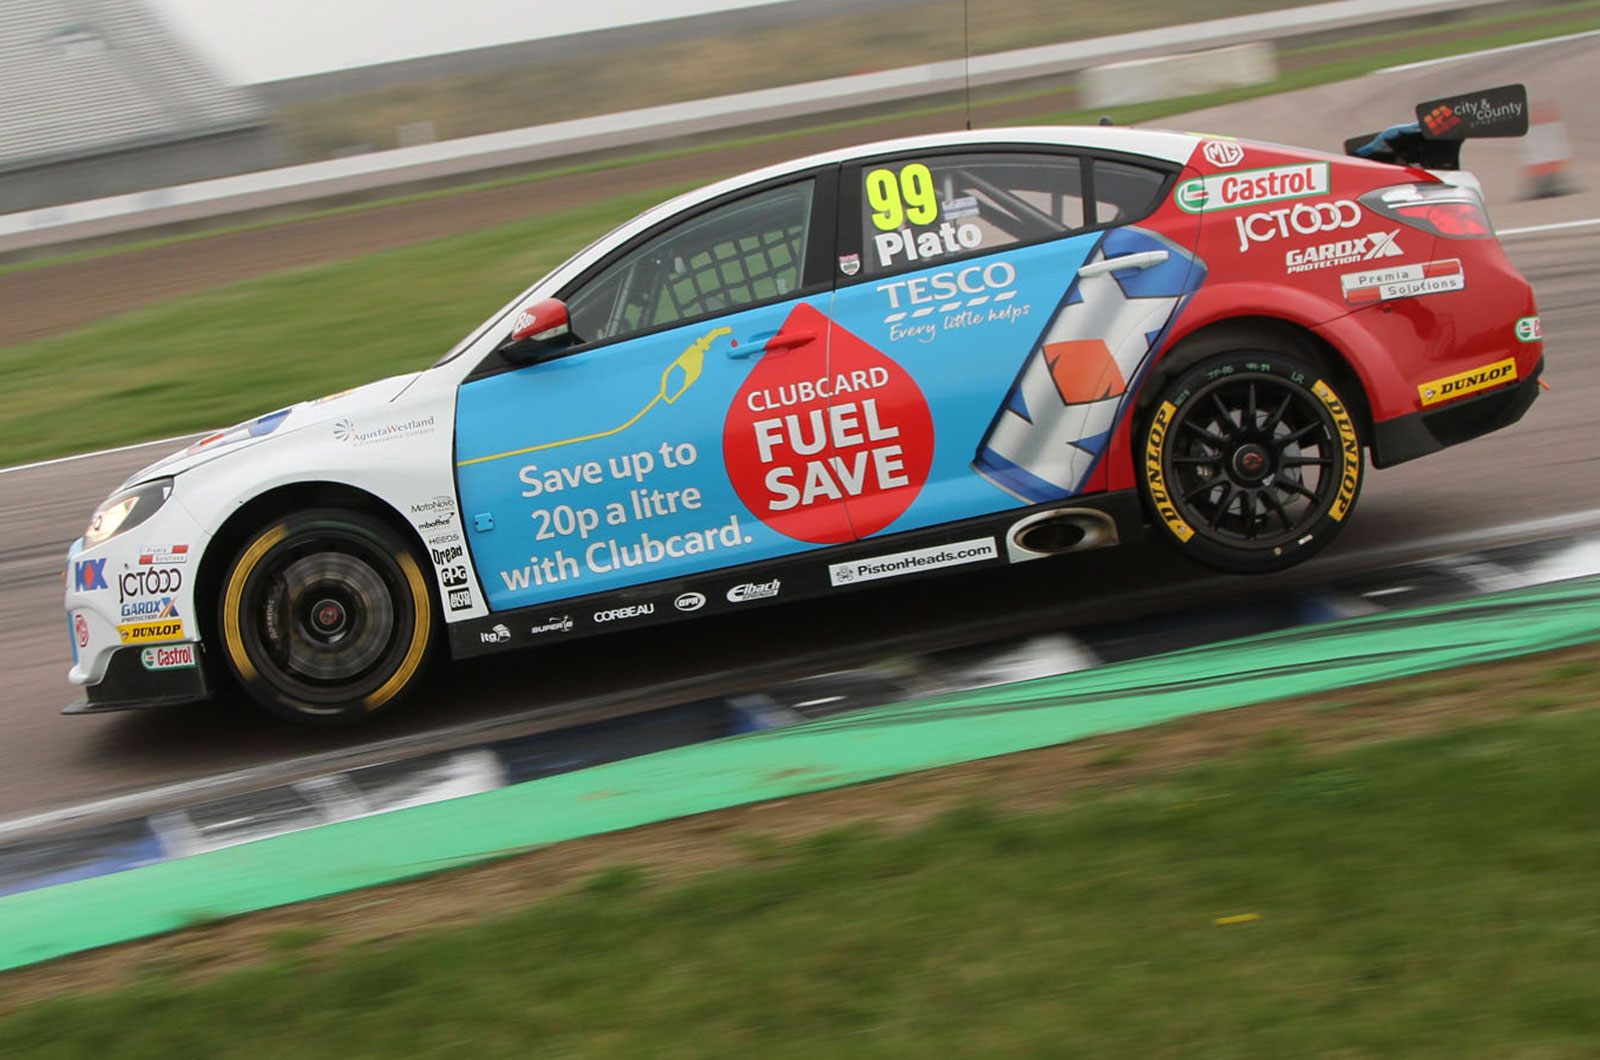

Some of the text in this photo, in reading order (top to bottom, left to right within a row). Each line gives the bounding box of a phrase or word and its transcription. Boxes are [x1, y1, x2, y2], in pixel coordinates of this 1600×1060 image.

[1454, 99, 1490, 115] city &
[1476, 102, 1522, 120] county
[1207, 144, 1241, 165] MG
[865, 163, 938, 231] 99
[1221, 167, 1316, 204] Castrol
[874, 222, 982, 267] Plato
[1287, 255, 1361, 274] PROTECTION
[1358, 270, 1410, 285] Premia
[876, 262, 1016, 310] TESCO
[1388, 278, 1457, 296] Solutions
[888, 304, 1031, 344] Every little helps
[747, 366, 890, 412] CLUBCARD
[1440, 364, 1513, 395] DUNLOP
[353, 416, 435, 441] AgustaWestland
[752, 398, 900, 463] FUEL
[518, 441, 698, 499] Save up to
[1148, 407, 1179, 524] DUNLOP
[1327, 399, 1358, 514] DUNLOP
[764, 445, 910, 511] SAVE
[411, 500, 455, 513] MotoNovo
[531, 485, 702, 541] 20p a litre
[500, 514, 753, 592] with Clubcard.
[857, 544, 993, 577] PistonHeads.com
[442, 567, 467, 584] PPG
[594, 603, 655, 623] CORBEAU
[132, 624, 181, 638] DUNLOP
[480, 631, 497, 643] itg
[157, 647, 193, 667] Castrol
